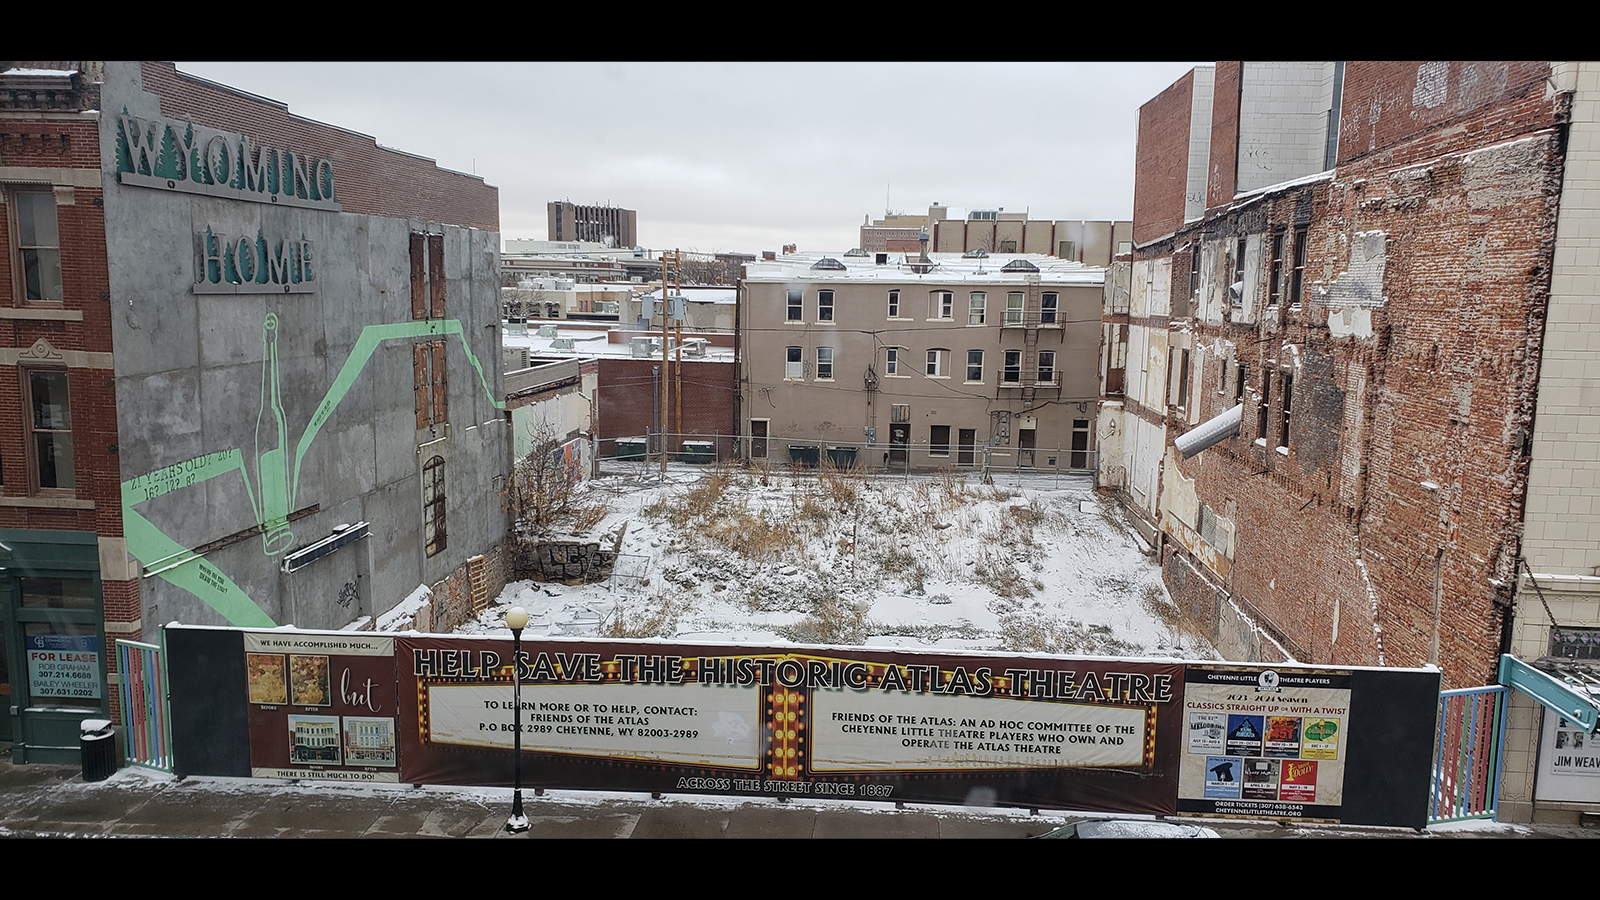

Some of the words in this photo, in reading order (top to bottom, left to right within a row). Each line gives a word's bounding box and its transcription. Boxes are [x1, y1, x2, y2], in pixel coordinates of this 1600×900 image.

[119, 114, 337, 202] WYOMING
[198, 229, 316, 285] HOME
[130, 478, 142, 490] 21
[145, 461, 183, 484] YEARS
[185, 452, 212, 472] OLD?
[144, 485, 159, 500] 16?
[165, 478, 180, 493] 12?
[186, 473, 196, 487] 8?
[294, 641, 348, 649] ACCOMPLISHED
[32, 652, 56, 661] FOR
[59, 653, 96, 662] LEASE
[38, 671, 92, 679] 307.214.6688
[412, 649, 500, 678] HELP
[519, 651, 602, 682] SAVE
[615, 654, 685, 684] THE
[698, 657, 870, 690] HISTORIC
[877, 664, 992, 696] ATLAS
[1004, 668, 1174, 702] THEATRE
[40, 688, 93, 696] 307.631.0202
[340, 668, 382, 712] but
[484, 700, 498, 709] TO
[502, 701, 536, 710] LERN
[540, 703, 570, 712] MORE
[574, 704, 590, 712] OR
[594, 704, 608, 713] TO
[612, 705, 640, 715] HELP,
[644, 706, 698, 716] CONTACT:
[1187, 702, 1224, 710] CLASSICS
[1226, 703, 1266, 712] STRAIGHT
[530, 714, 572, 723] FRIENDS
[576, 715, 590, 724] OF
[594, 716, 614, 724] THE
[617, 716, 650, 726] ATLAS
[832, 712, 876, 723] FRIENDS
[878, 714, 894, 724] OF
[897, 715, 918, 725] THE
[920, 716, 956, 726] ATLAS:
[960, 718, 976, 728] AN
[980, 719, 996, 728] AD
[999, 720, 1024, 730] HOC
[1027, 721, 1092, 732] COMMITTEE
[1096, 724, 1110, 734] OF
[1114, 725, 1136, 734] THE
[479, 723, 498, 731] P.O
[528, 724, 552, 734] 2989
[556, 726, 614, 736] CHEYENNE,
[618, 727, 634, 736] WY
[638, 728, 698, 738] 82003-2989
[841, 724, 898, 736] CHEYENNE
[901, 727, 934, 738] LITTLE
[938, 728, 986, 740] THEATRE
[989, 730, 1034, 742] PLAYERS
[1038, 732, 1066, 743] WHO
[1068, 734, 1096, 744] OWN
[1100, 736, 1124, 746] AND
[1270, 728, 1293, 740] 451
[901, 738, 950, 750] OPERATE
[953, 740, 974, 750] THE
[976, 742, 1010, 752] ATLAS
[1014, 743, 1062, 754] THEATRE
[1554, 756, 1572, 766] JIM
[676, 776, 730, 790] ACROSS
[733, 778, 760, 791] THE
[764, 780, 812, 793] STREET
[814, 782, 856, 795] SINCE
[860, 784, 894, 796] 1887
[1216, 808, 1302, 816] CHEYENNELITTLETHEATRE.ORG
